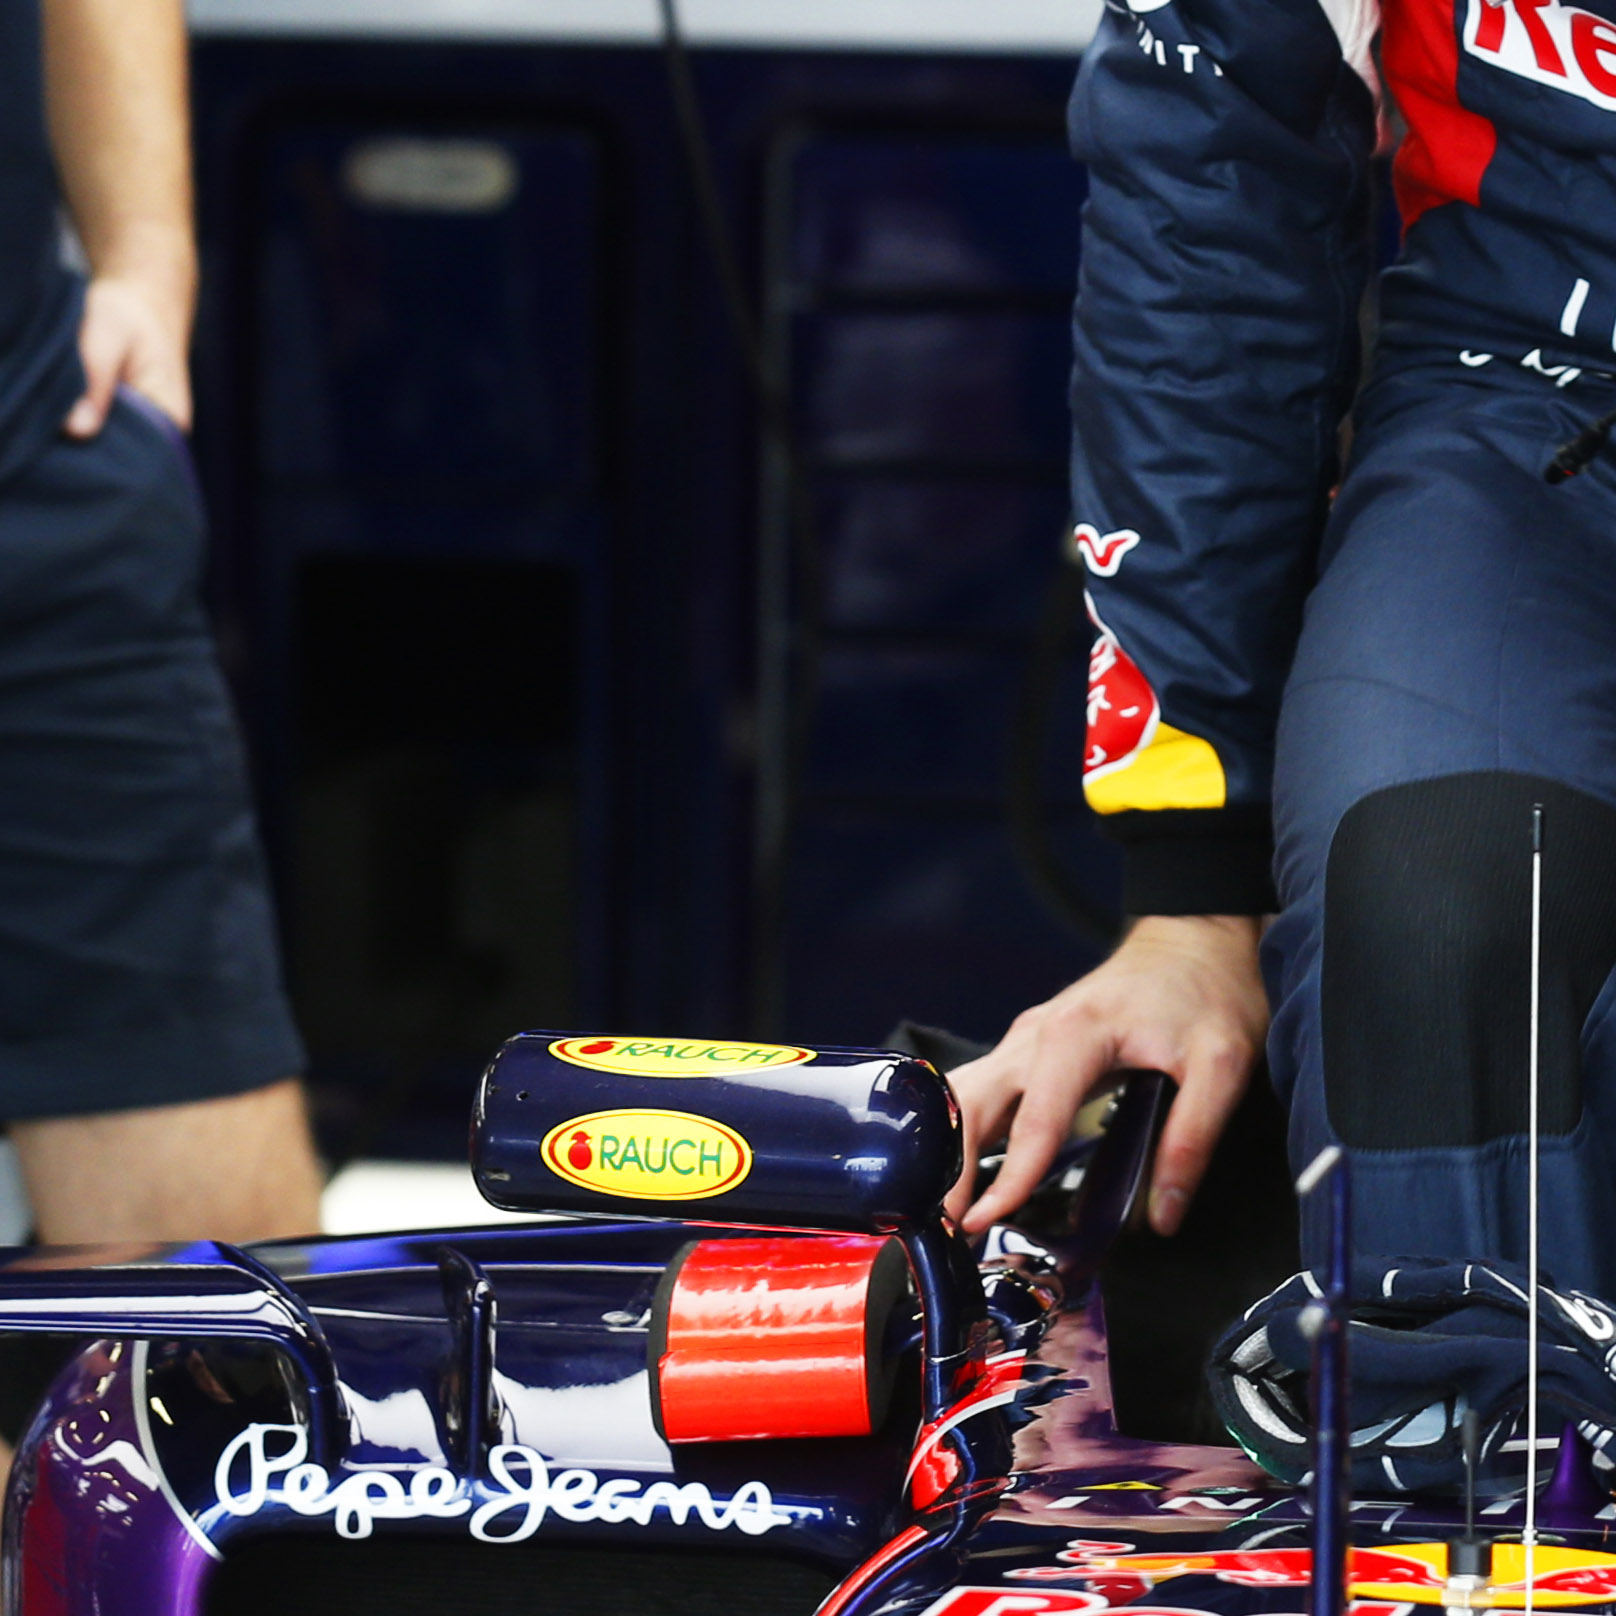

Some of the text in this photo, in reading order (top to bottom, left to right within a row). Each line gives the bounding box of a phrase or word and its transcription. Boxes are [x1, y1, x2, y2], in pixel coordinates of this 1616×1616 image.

[612, 1041, 780, 1067] RAUCH
[599, 1134, 725, 1178] RAUCH
[215, 1423, 792, 1544] Pepe Jeans
